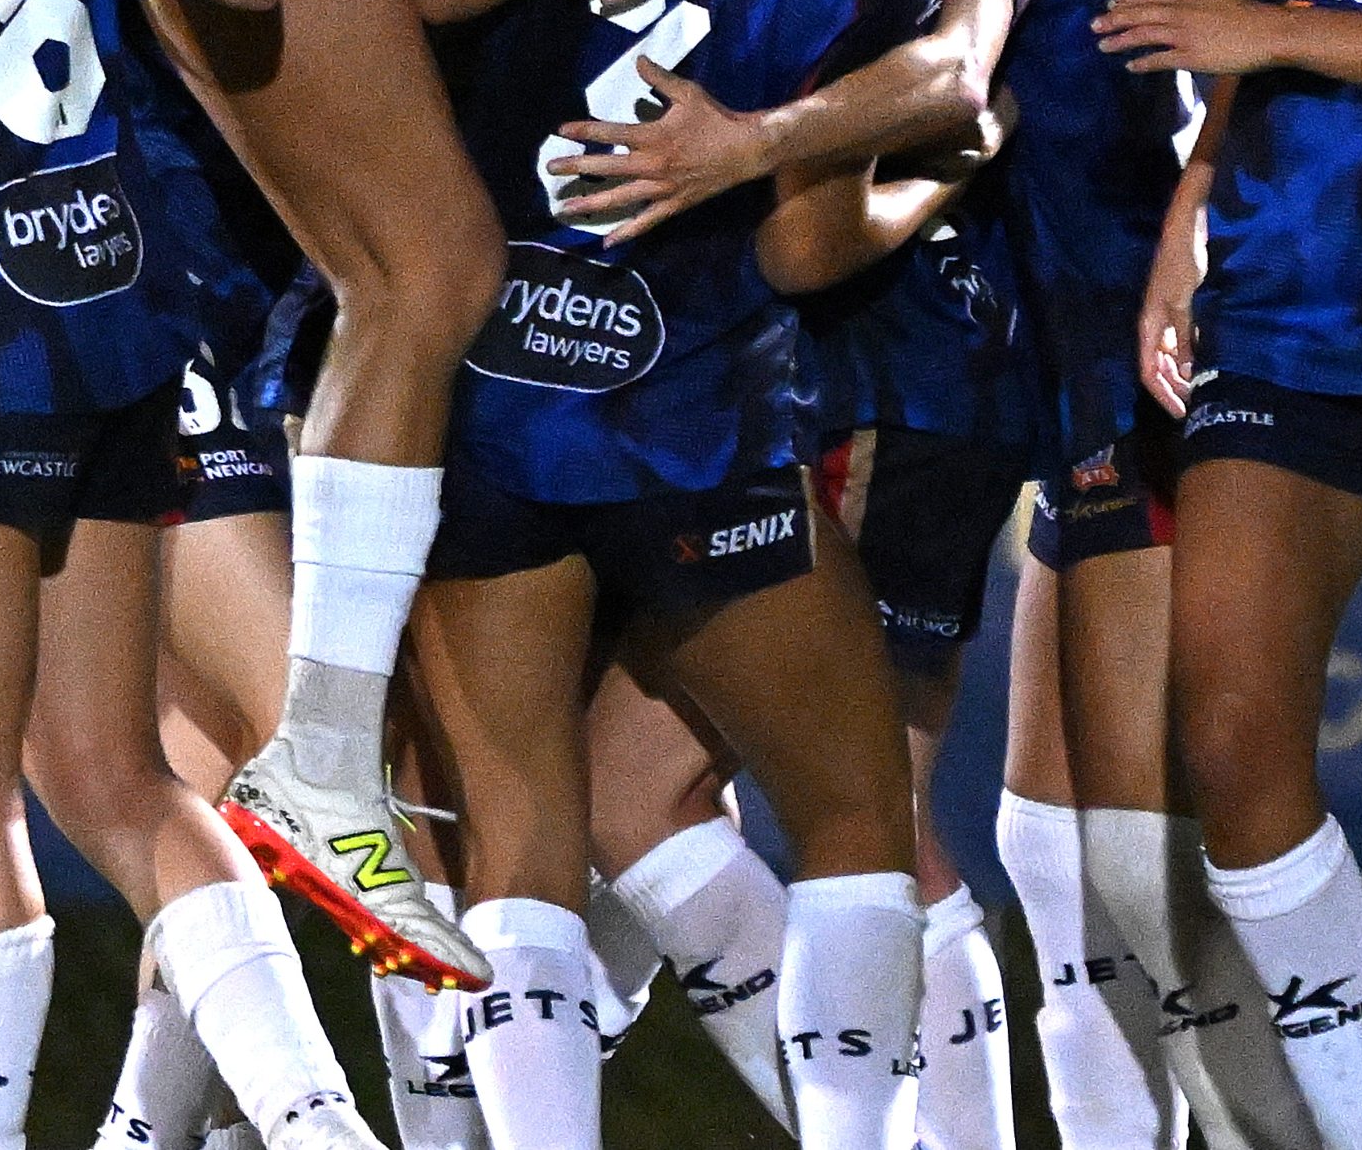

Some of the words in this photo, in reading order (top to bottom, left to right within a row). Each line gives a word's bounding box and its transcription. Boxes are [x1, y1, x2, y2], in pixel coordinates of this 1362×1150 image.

[501, 277, 643, 337] rydens
[523, 322, 632, 370] lawyers
[199, 450, 247, 466] PORT
[708, 508, 796, 557] SENIX
[465, 989, 600, 1043] JETS
